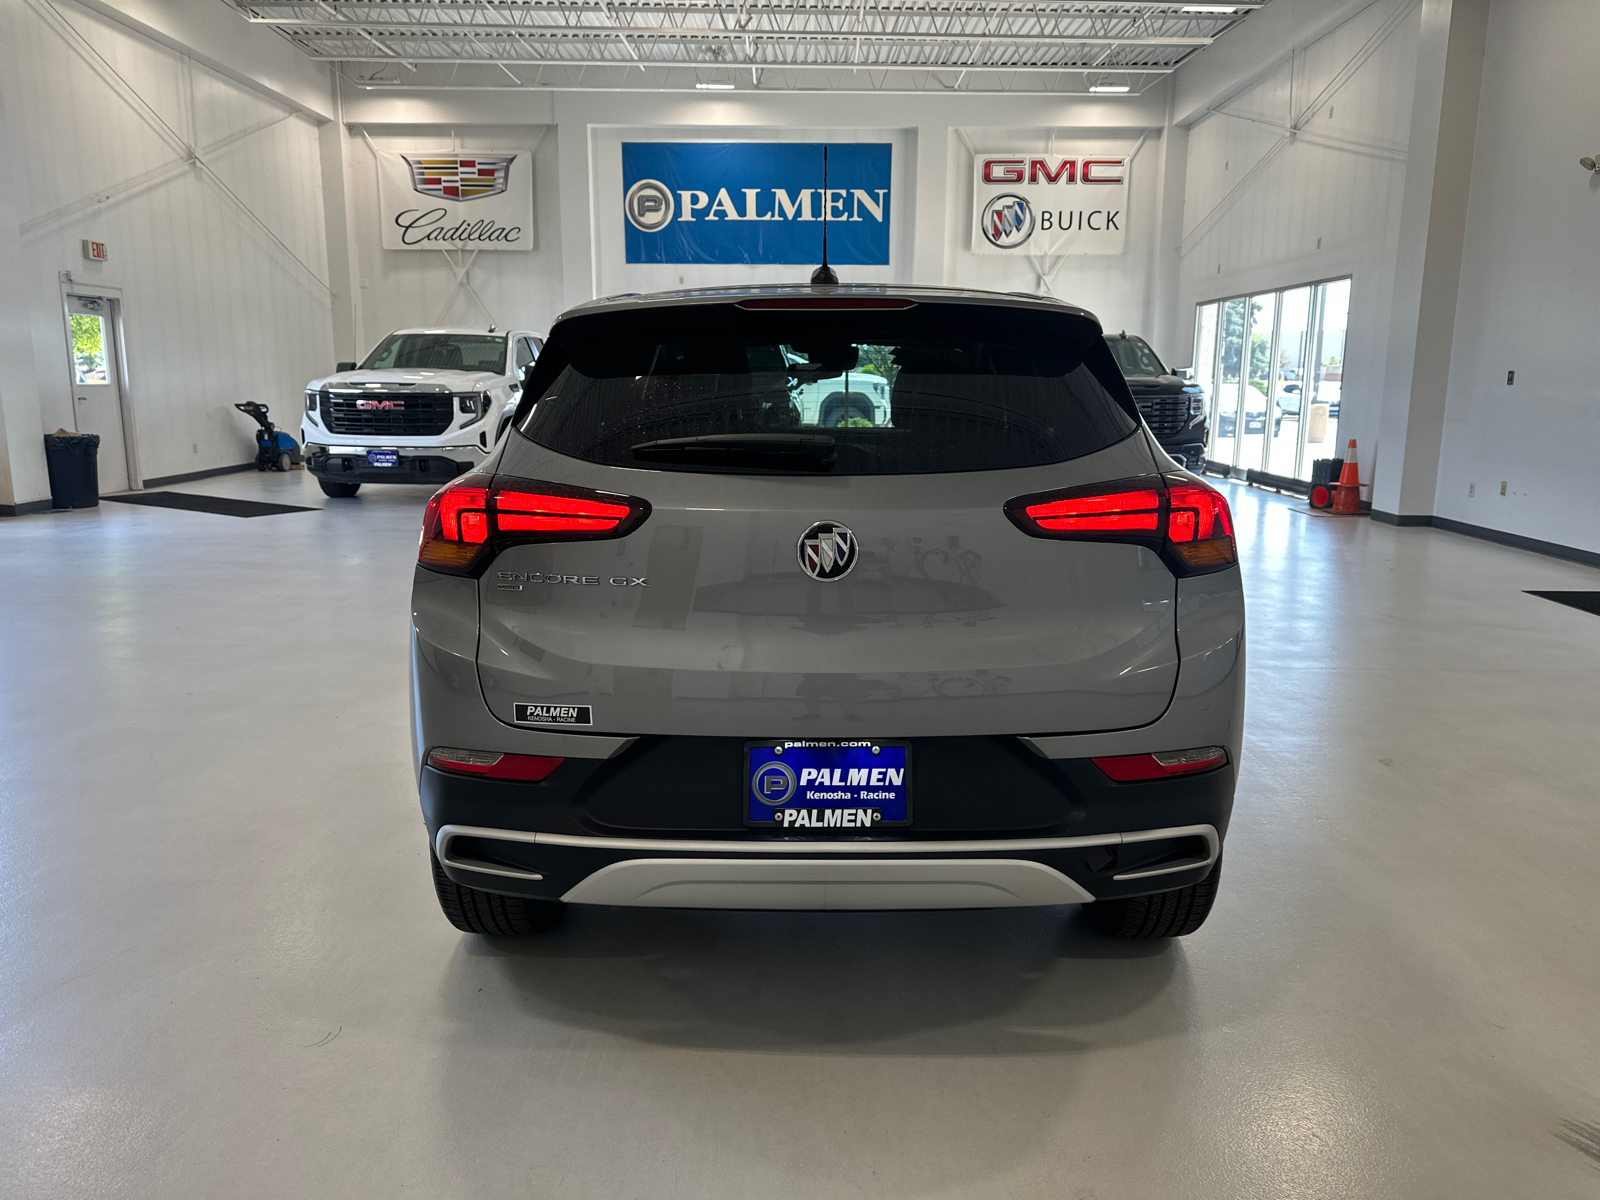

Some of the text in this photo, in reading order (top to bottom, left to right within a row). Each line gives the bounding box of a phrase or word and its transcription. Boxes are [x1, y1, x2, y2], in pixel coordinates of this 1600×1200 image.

[982, 158, 1125, 185] GMC
[676, 187, 889, 223] PALMEN
[394, 207, 521, 245] Cadillac
[1040, 210, 1120, 231] BUICK
[91, 241, 105, 259] EXIT
[356, 400, 405, 410] GMC
[498, 571, 650, 587] ENCORE GX
[526, 706, 577, 717] PALMEN
[784, 740, 872, 749] palmen.com
[799, 767, 905, 786] PALMEN
[806, 790, 851, 799] Kenosha
[860, 790, 896, 799] Racine
[783, 808, 873, 828] PALMEN
